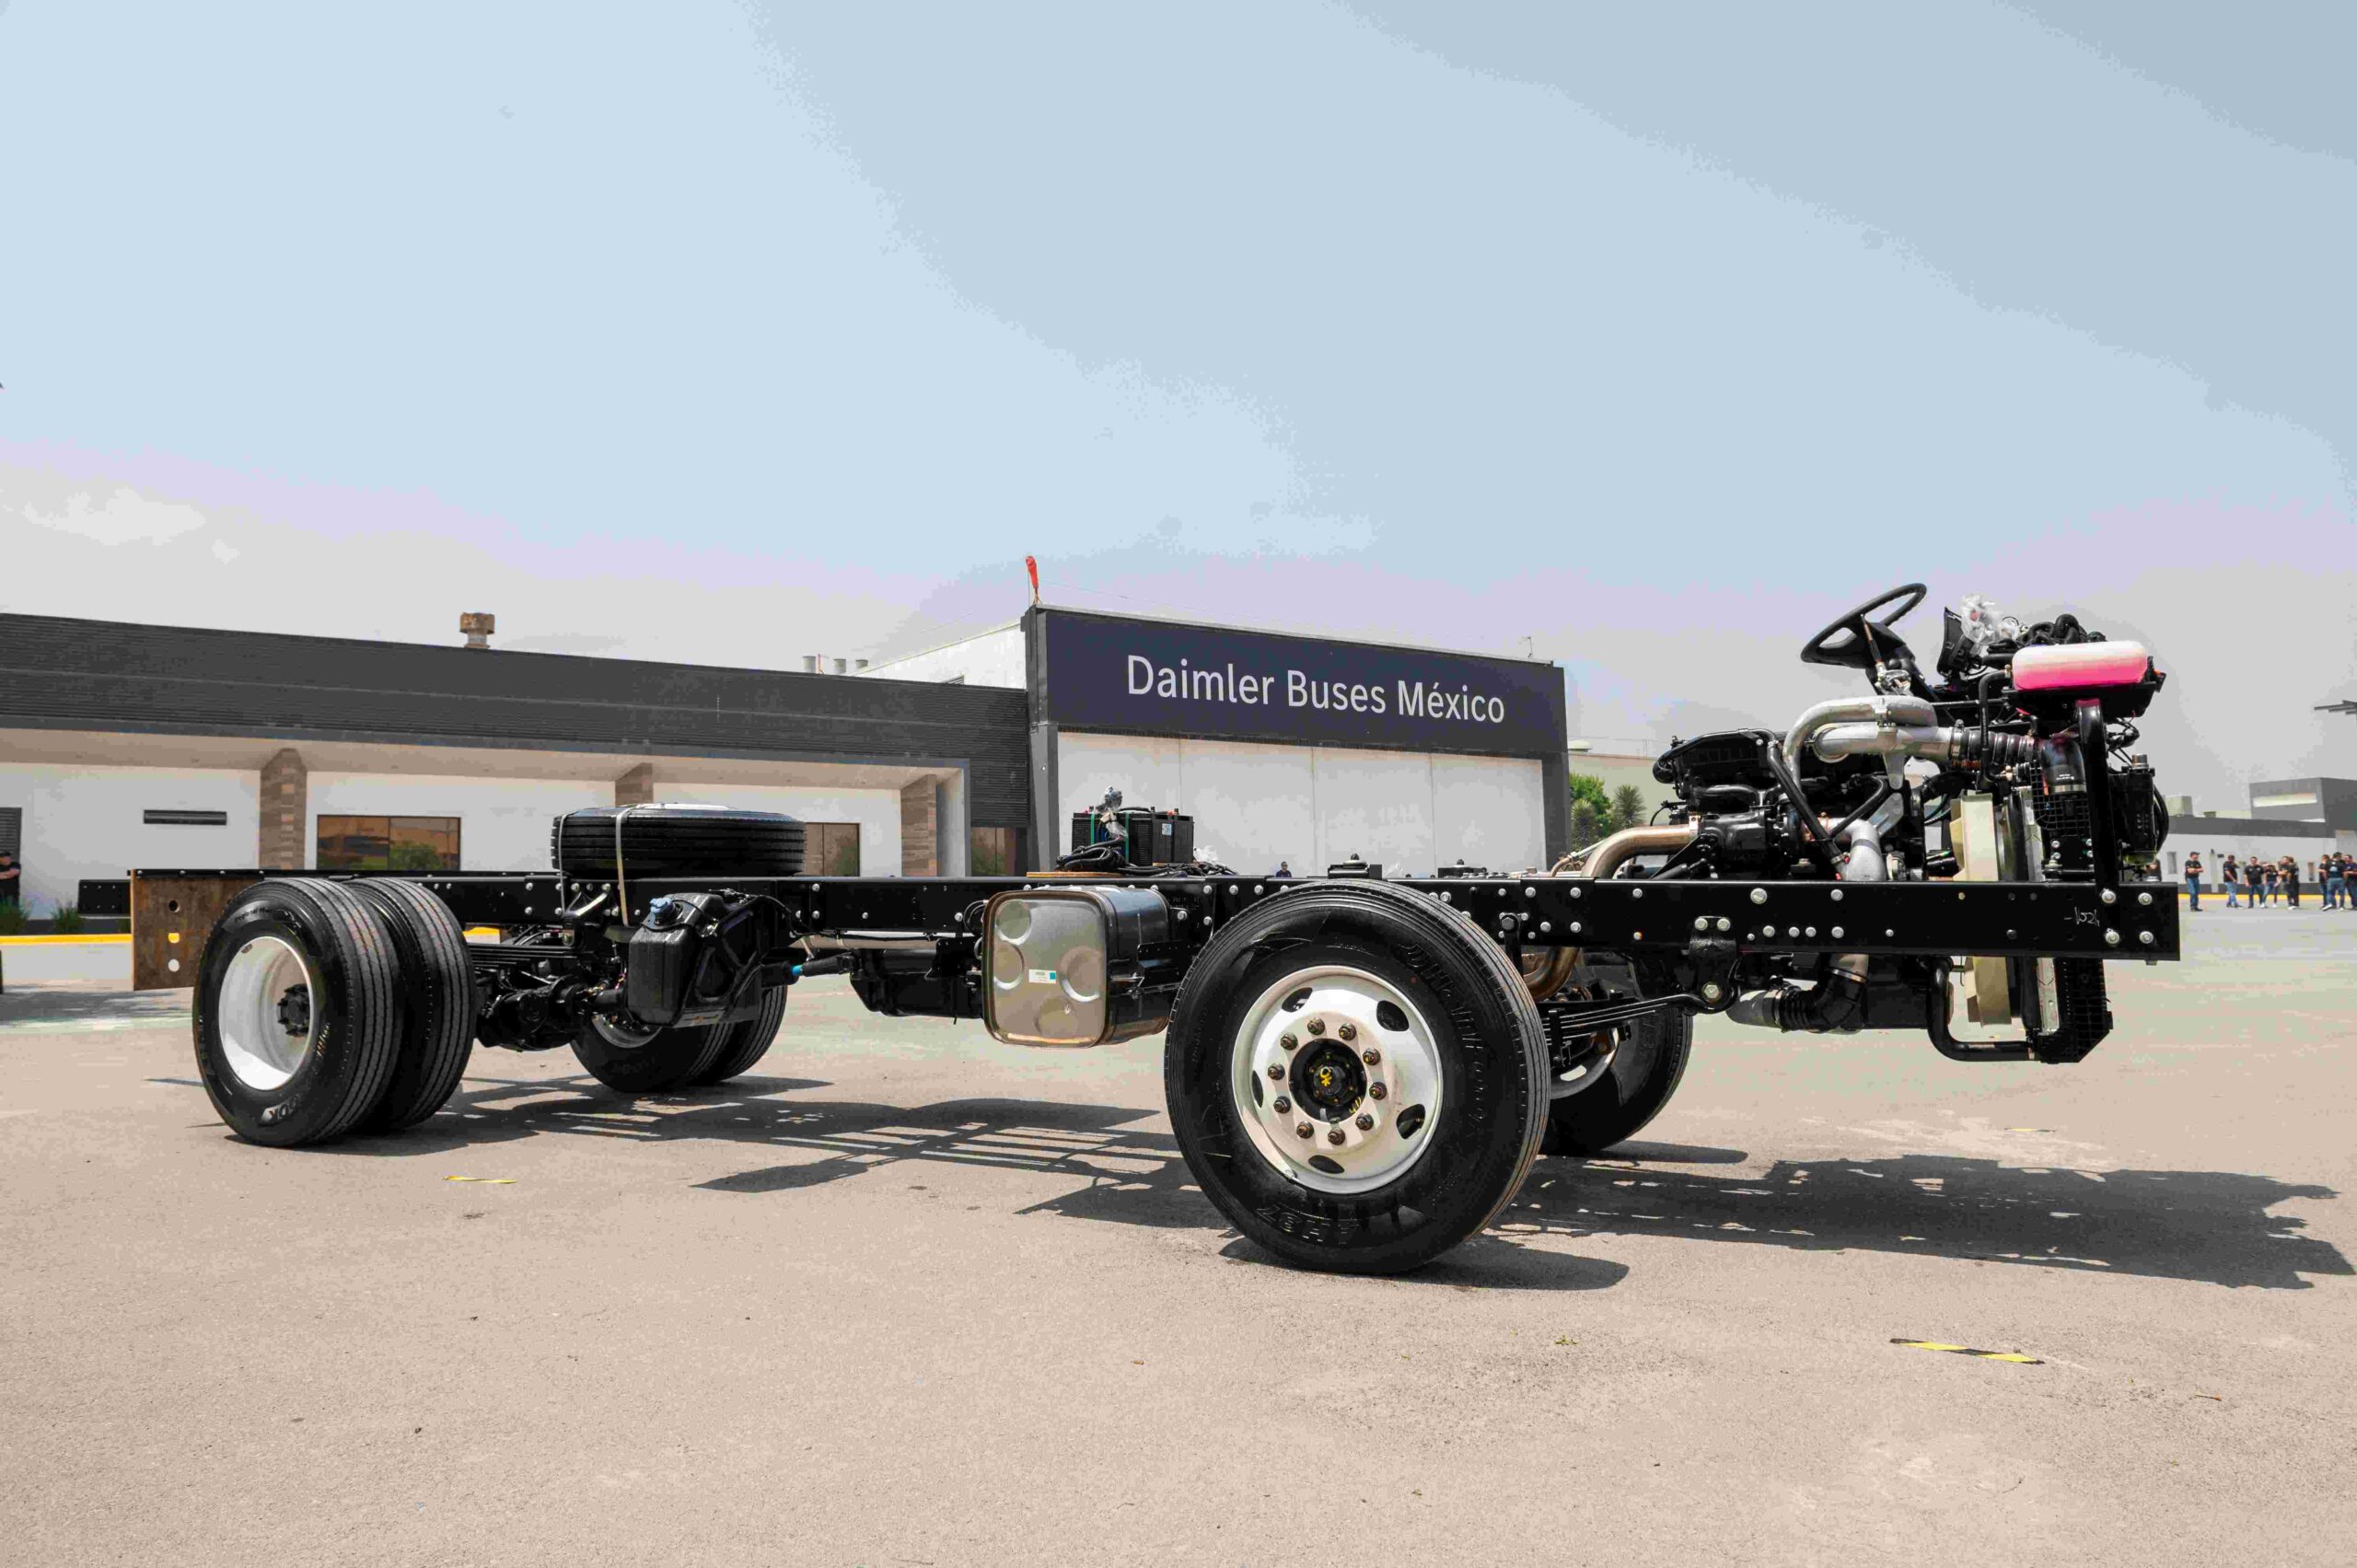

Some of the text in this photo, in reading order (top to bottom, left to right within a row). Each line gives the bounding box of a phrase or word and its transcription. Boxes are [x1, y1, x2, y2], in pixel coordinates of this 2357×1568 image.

[1128, 655, 1504, 724] Daimler Buses México
